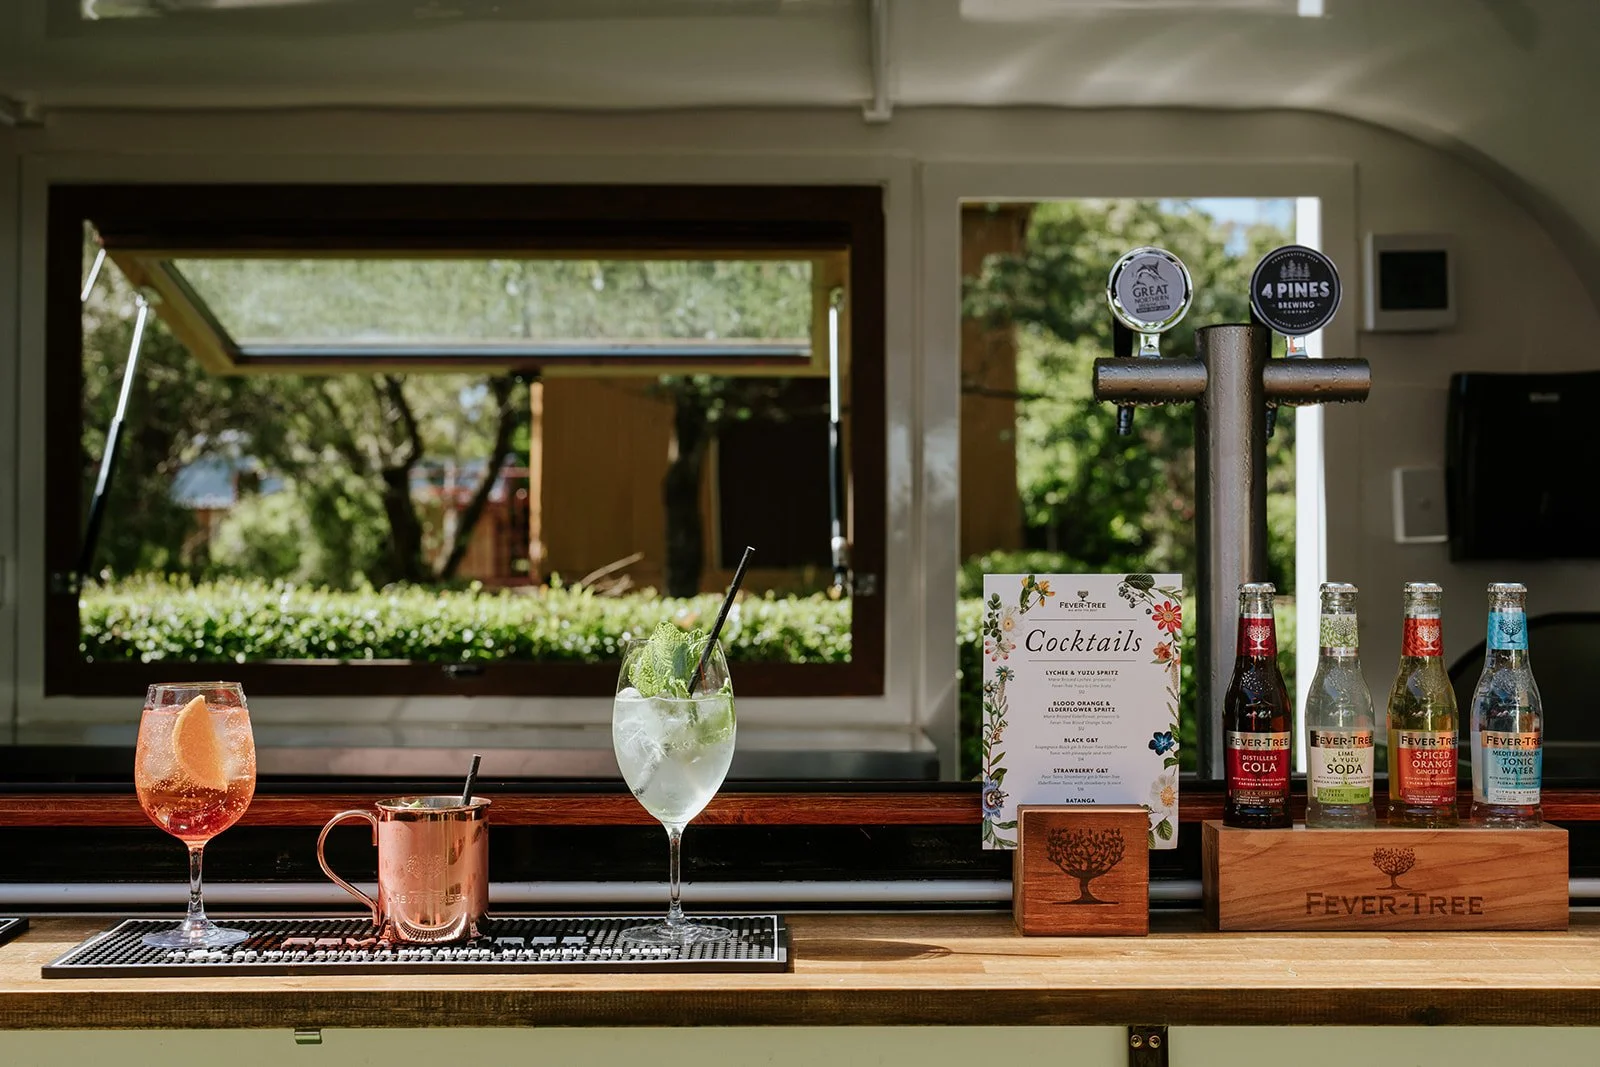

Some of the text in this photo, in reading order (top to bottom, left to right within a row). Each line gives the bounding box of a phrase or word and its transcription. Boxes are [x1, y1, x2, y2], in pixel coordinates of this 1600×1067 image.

[1133, 284, 1169, 298] GREAT
[1261, 281, 1330, 299] 4 PINES
[1278, 301, 1316, 309] BREWING
[1025, 628, 1143, 653] Cocktails
[1229, 736, 1289, 747] FEVER-TREE
[1314, 735, 1374, 746] FEVER-TREE
[1415, 751, 1451, 759] SPICED
[1242, 762, 1277, 772] COLA
[1412, 760, 1453, 768] ORANGE
[1502, 758, 1533, 766] TONIC
[1326, 764, 1364, 774] SODA
[1306, 892, 1484, 915] FEVER-TREE
